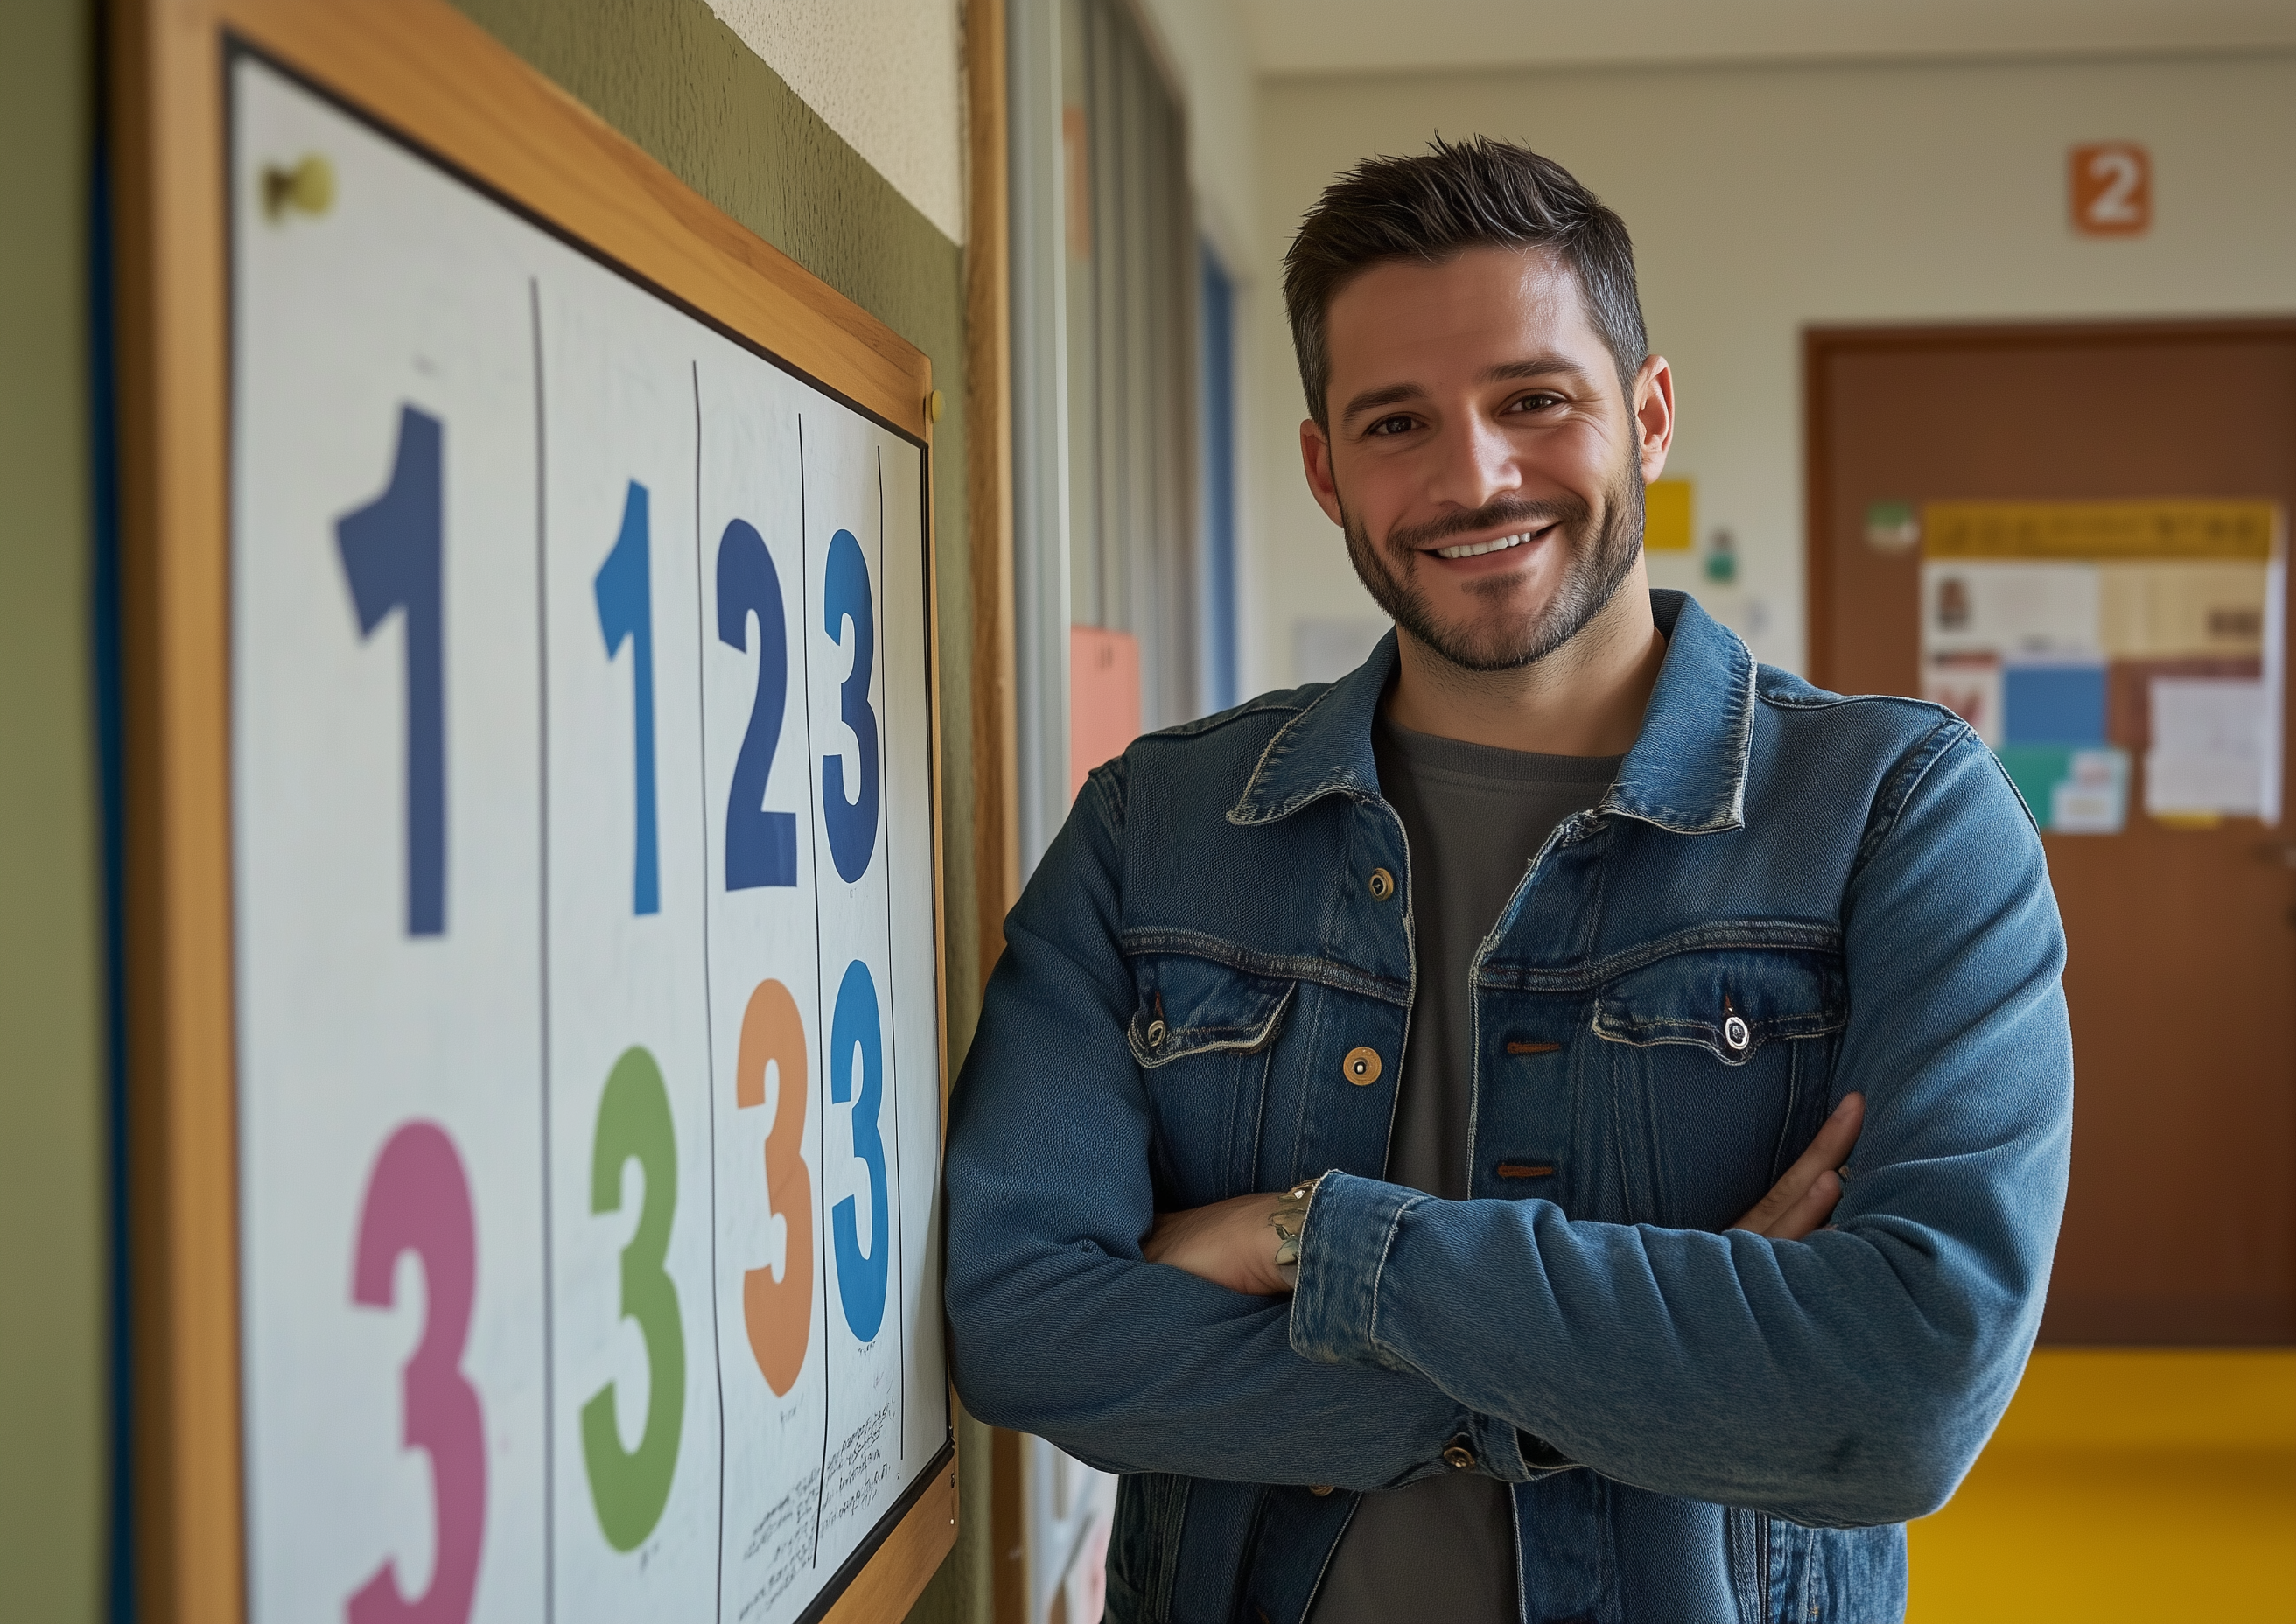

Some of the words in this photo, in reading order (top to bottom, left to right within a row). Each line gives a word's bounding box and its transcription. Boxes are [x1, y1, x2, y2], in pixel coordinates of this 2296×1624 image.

[2089, 155, 2138, 221] 2
[333, 402, 445, 939] 1
[593, 478, 661, 916] 1
[717, 518, 797, 892] 2
[822, 528, 879, 883] 3
[342, 1117, 491, 1624] 3
[580, 1045, 686, 1554] 3
[736, 977, 815, 1397] 3
[830, 959, 889, 1343] 3
